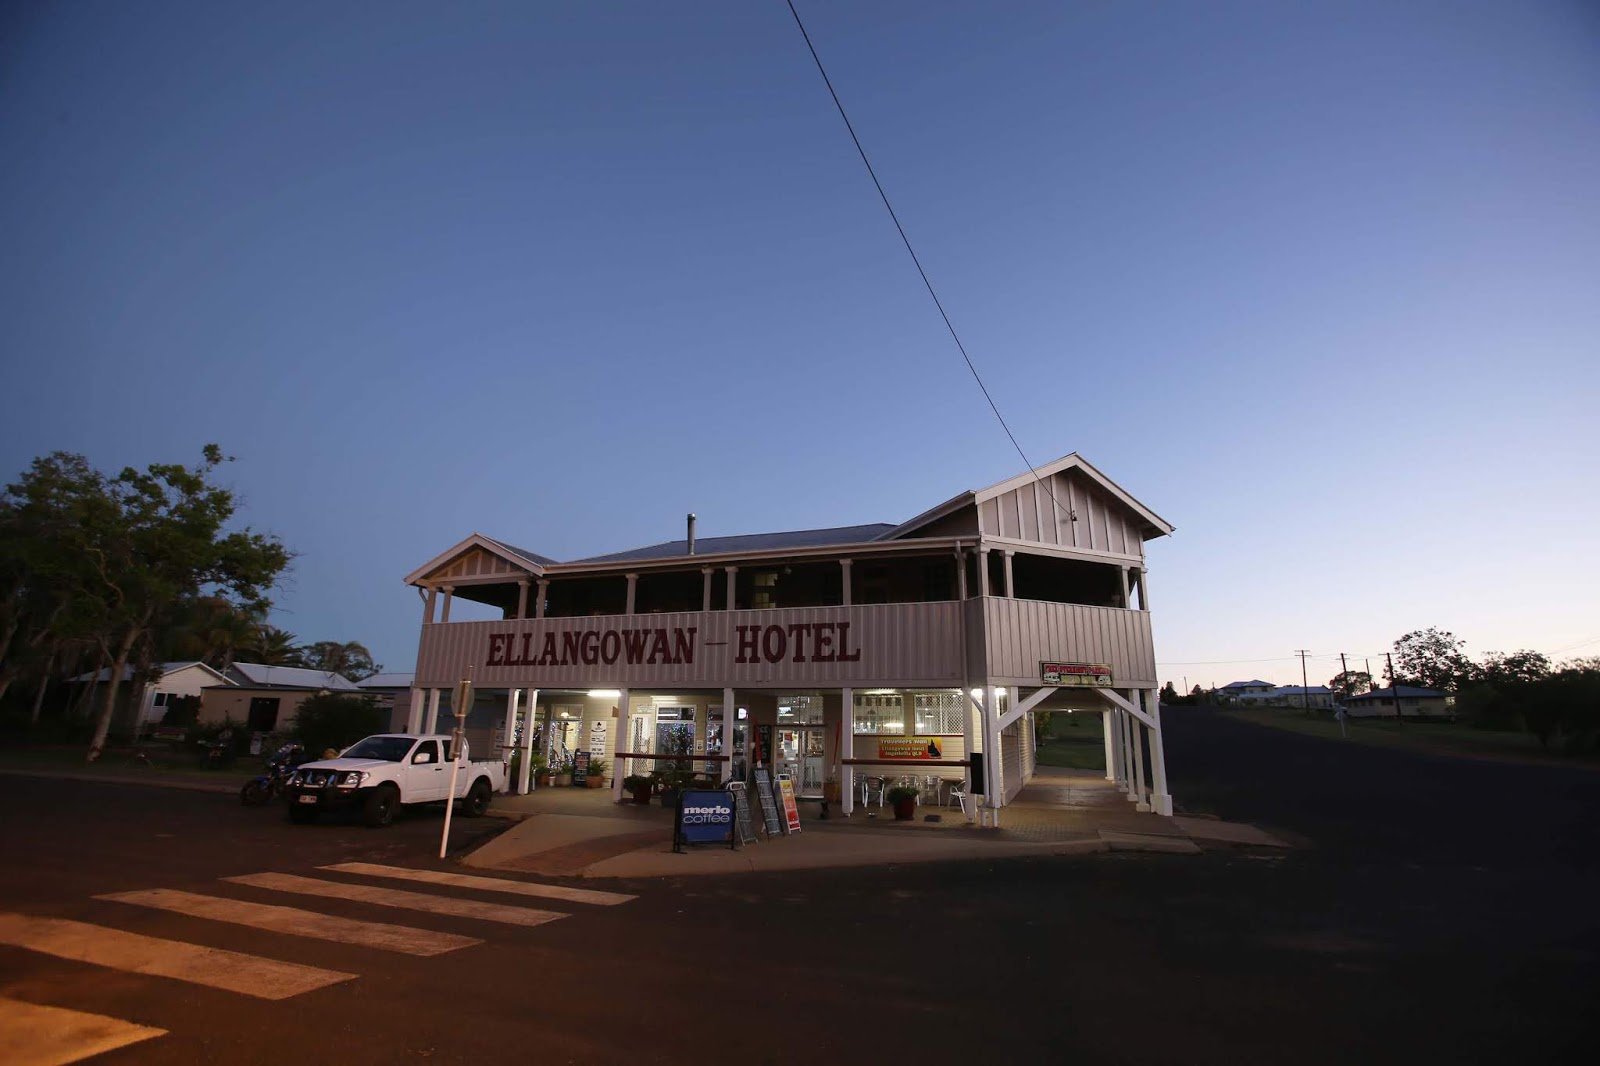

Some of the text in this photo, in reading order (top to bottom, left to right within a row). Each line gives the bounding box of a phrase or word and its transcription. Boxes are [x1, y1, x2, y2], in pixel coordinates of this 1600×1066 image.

[486, 627, 698, 666] ELLANGOWAN
[735, 622, 861, 664] HOTEL
[683, 805, 731, 814] merlo
[683, 814, 730, 824] coffee
